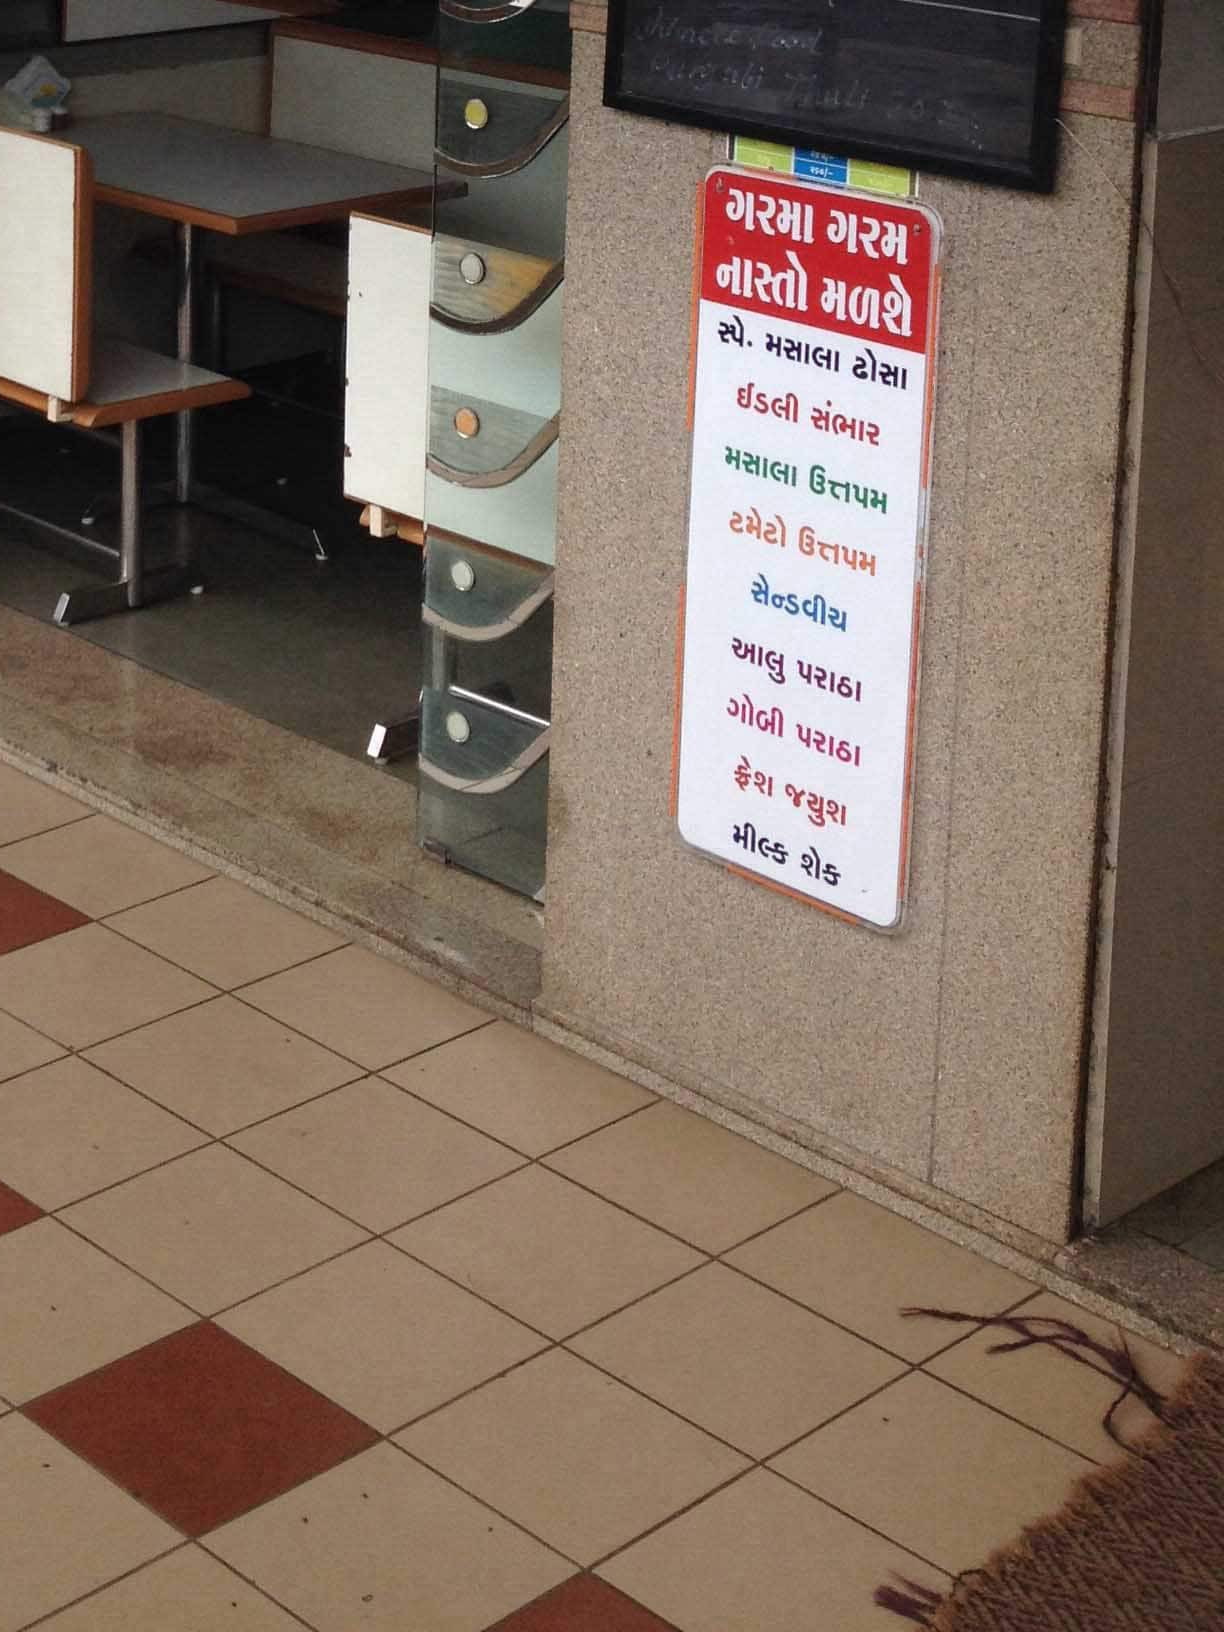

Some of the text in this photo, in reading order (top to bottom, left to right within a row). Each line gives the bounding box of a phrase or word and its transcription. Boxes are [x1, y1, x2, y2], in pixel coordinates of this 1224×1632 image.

[726, 188, 908, 265] ગરમા ગરમ
[716, 249, 912, 336] નાસ્તો મળશે
[765, 332, 840, 372] મસાલા
[852, 347, 908, 390] ઢોસા
[736, 382, 881, 446] ઈડલી સંભાર
[724, 445, 888, 514] મસાલા ઉત્તપમ
[729, 506, 877, 577] ટમેટો ઉત્તપમ
[731, 637, 862, 702] આલુ પરાઠા
[726, 694, 861, 767] ગોબી પરાઠા
[732, 822, 842, 886] મીલ્ક શેક
